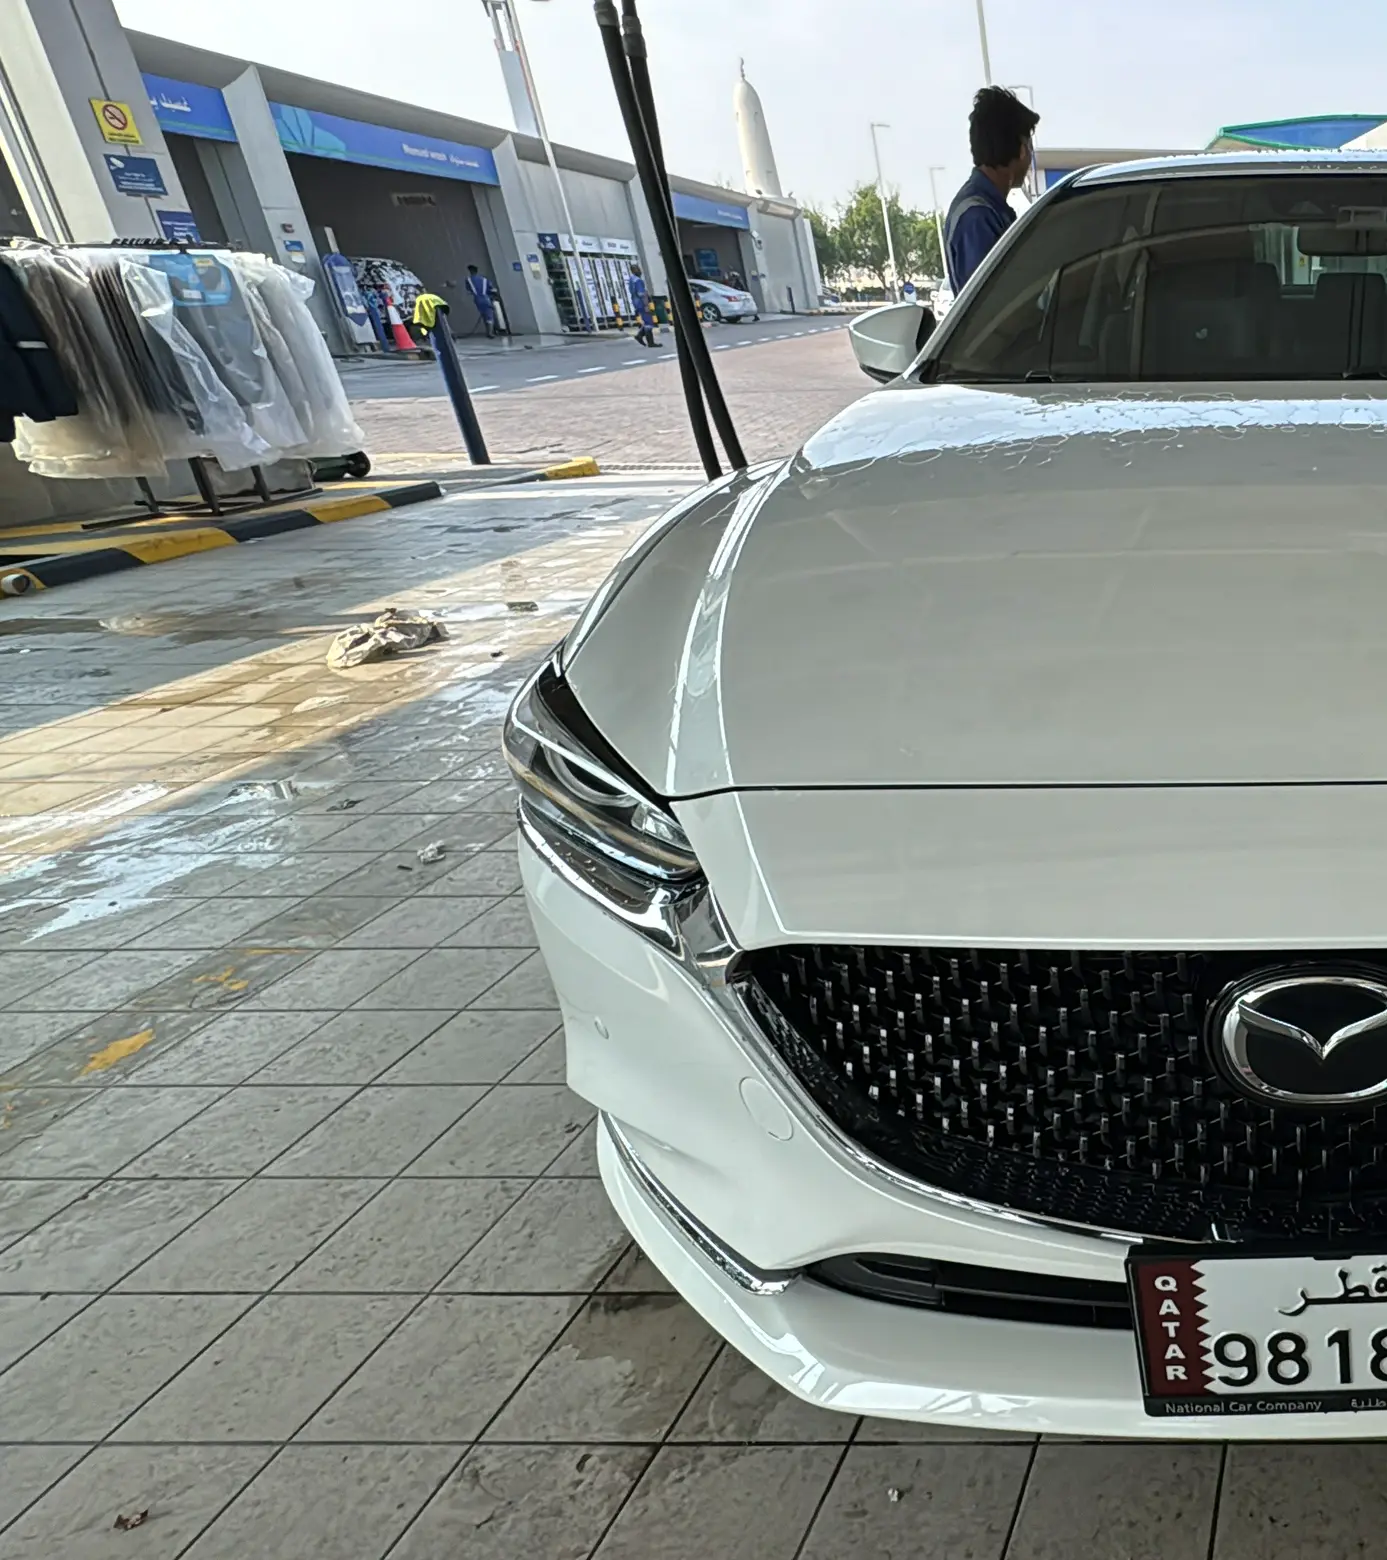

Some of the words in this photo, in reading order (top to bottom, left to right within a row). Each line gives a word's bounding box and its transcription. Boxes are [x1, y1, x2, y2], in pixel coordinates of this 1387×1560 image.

[1154, 1275, 1189, 1381] QATAR
[1165, 1402, 1224, 1414] National
[1229, 1401, 1252, 1412] Car
[1256, 1400, 1322, 1412] Company
